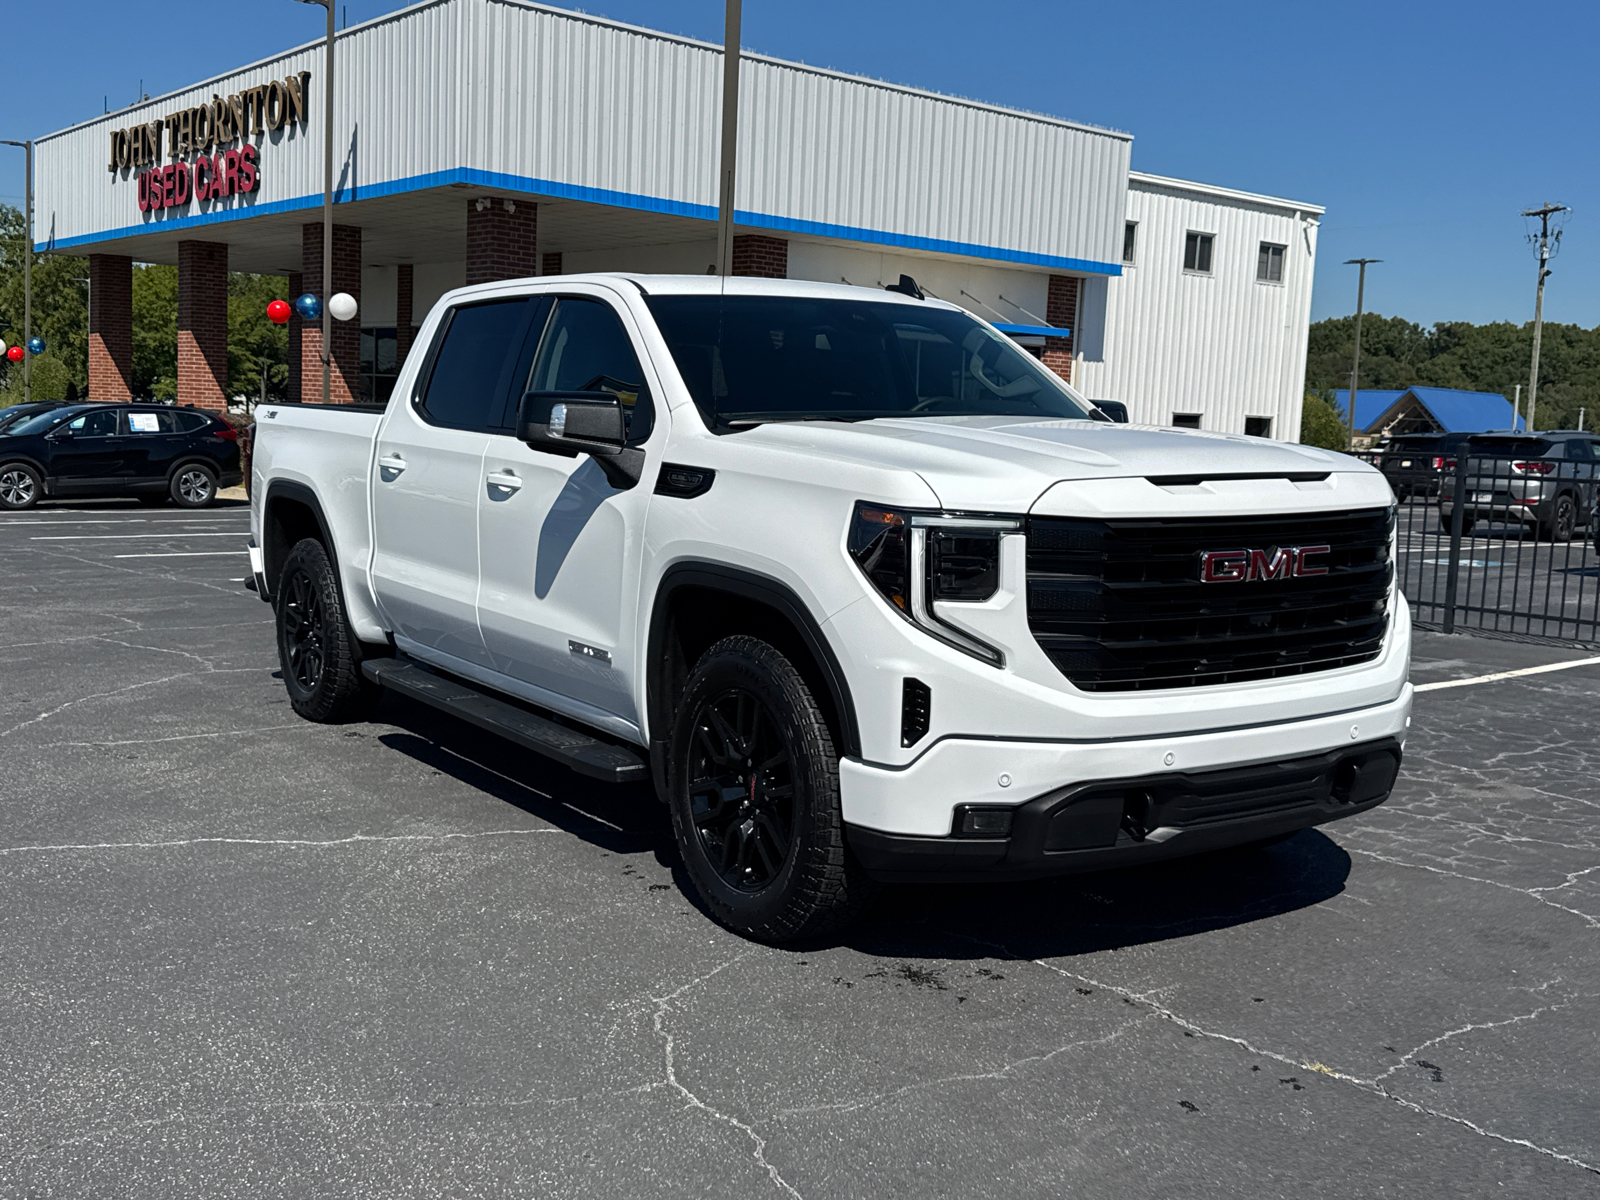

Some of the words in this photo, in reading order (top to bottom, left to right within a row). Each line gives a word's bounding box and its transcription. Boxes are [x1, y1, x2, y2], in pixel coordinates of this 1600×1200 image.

[108, 120, 163, 172] JOHN
[165, 71, 311, 157] THORNTON
[138, 162, 189, 212] USED
[194, 143, 259, 201] CARS
[1200, 544, 1331, 583] GMC
